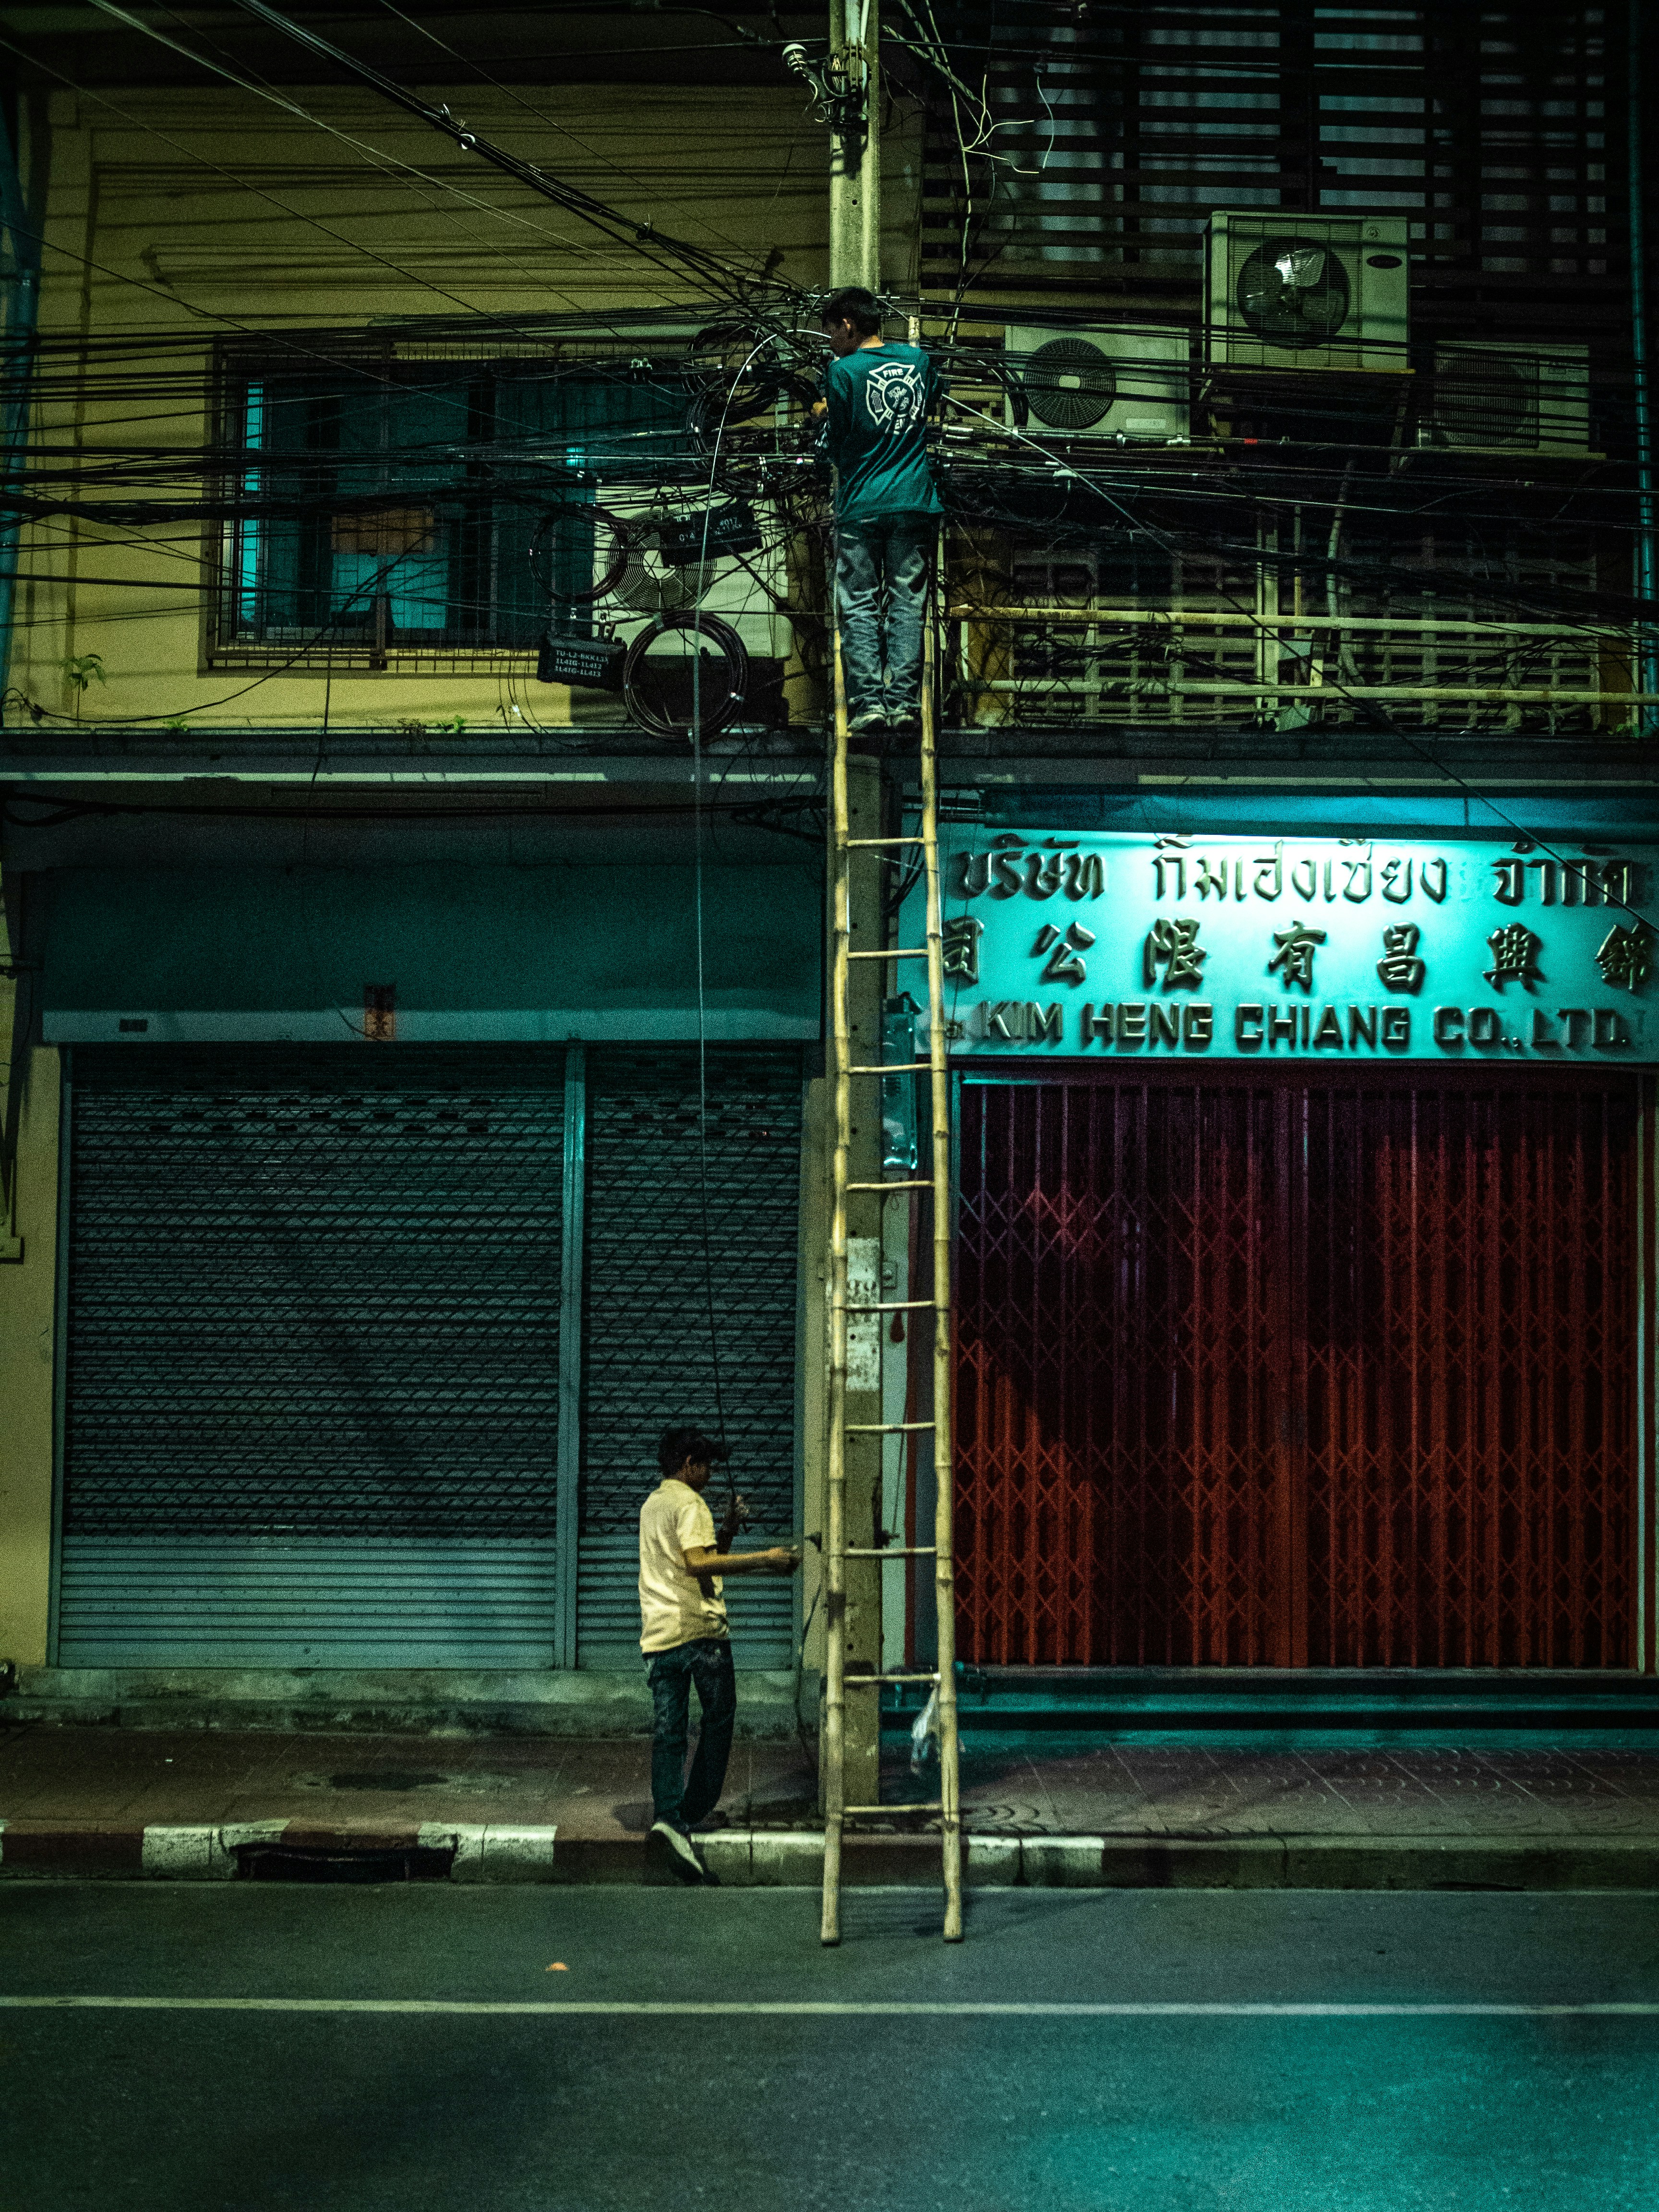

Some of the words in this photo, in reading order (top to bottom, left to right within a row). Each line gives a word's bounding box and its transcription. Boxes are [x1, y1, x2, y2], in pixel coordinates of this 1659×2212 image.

[882, 368, 904, 378] FIRE
[958, 833, 1105, 901] บริษัท
[979, 1001, 1063, 1040] KIM
[1081, 1002, 1213, 1049] HENG
[1236, 1003, 1410, 1050] CHIANG
